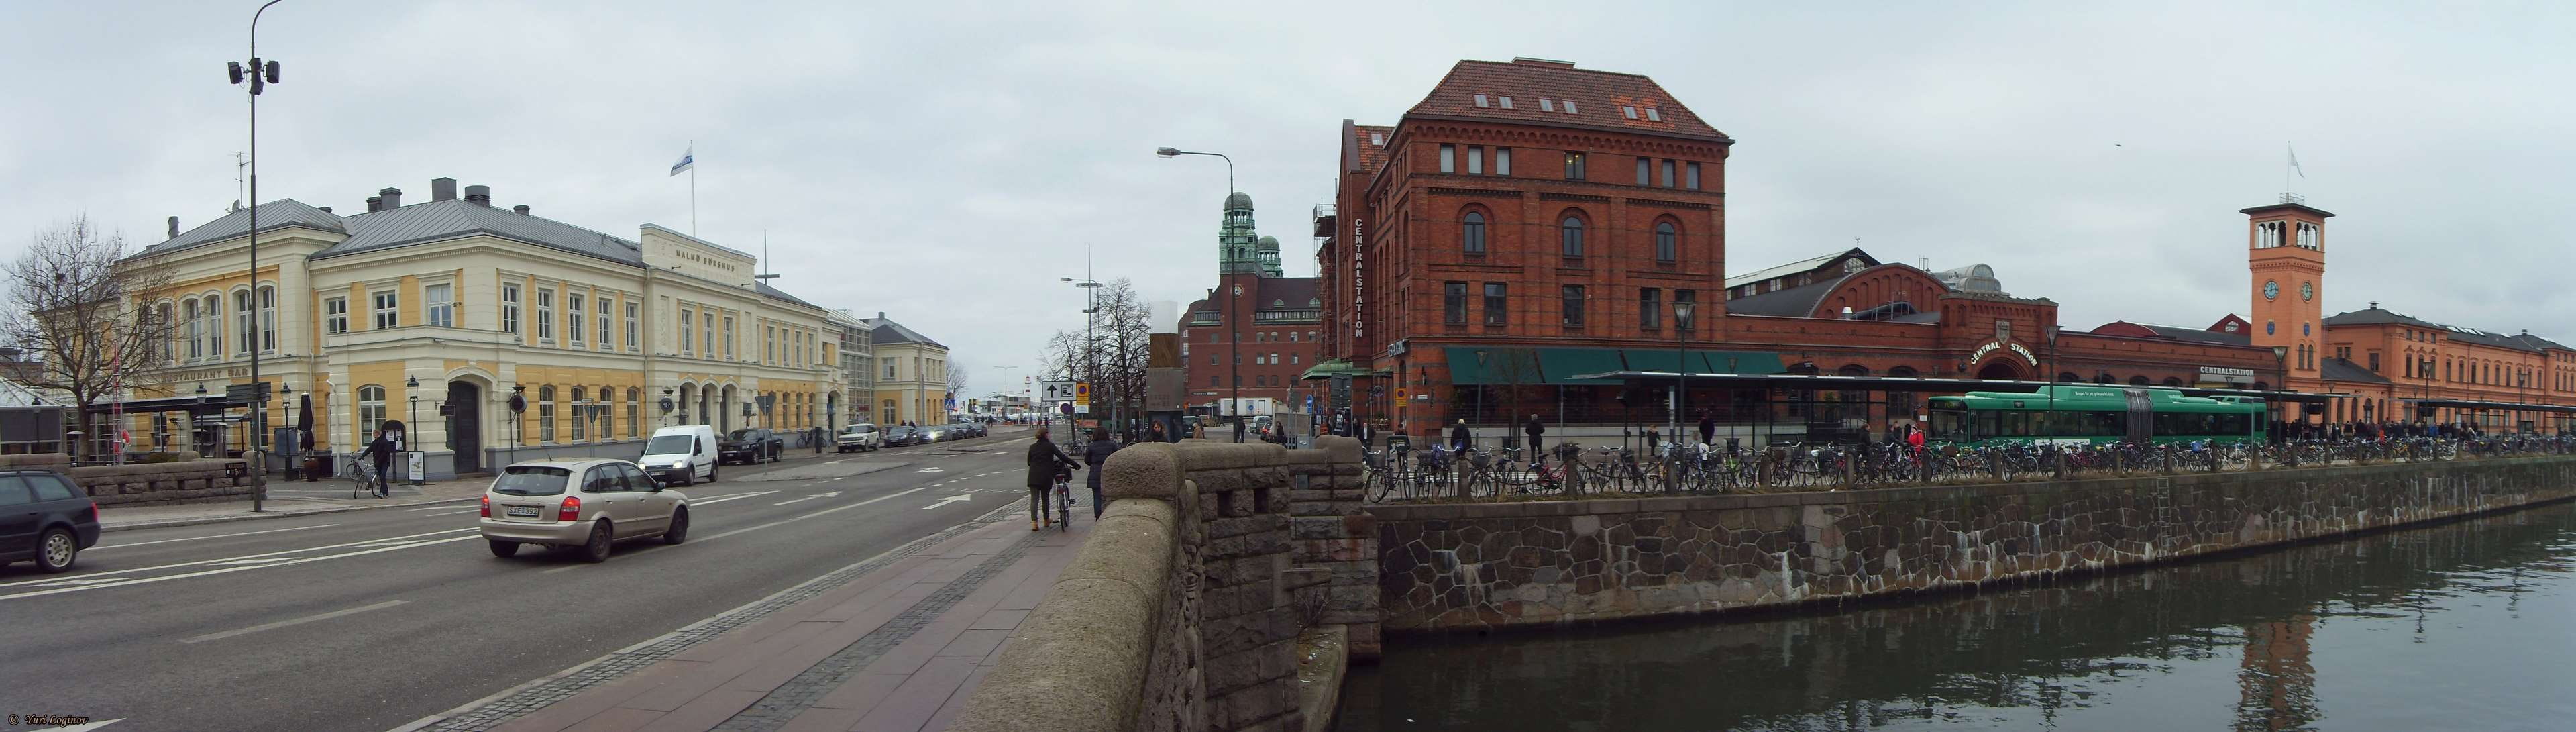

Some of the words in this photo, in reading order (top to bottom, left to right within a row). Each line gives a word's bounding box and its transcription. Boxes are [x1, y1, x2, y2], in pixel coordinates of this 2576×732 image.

[676, 249, 700, 262] MALMÖ
[703, 257, 735, 272] BÖRSHUS
[1355, 219, 1363, 337] CENTRALSTATION
[1971, 342, 2000, 364] CENTRAL
[2010, 343, 2038, 366] STATION
[228, 367, 248, 377] BAR
[2200, 366, 2254, 376] CENTRALSTATION
